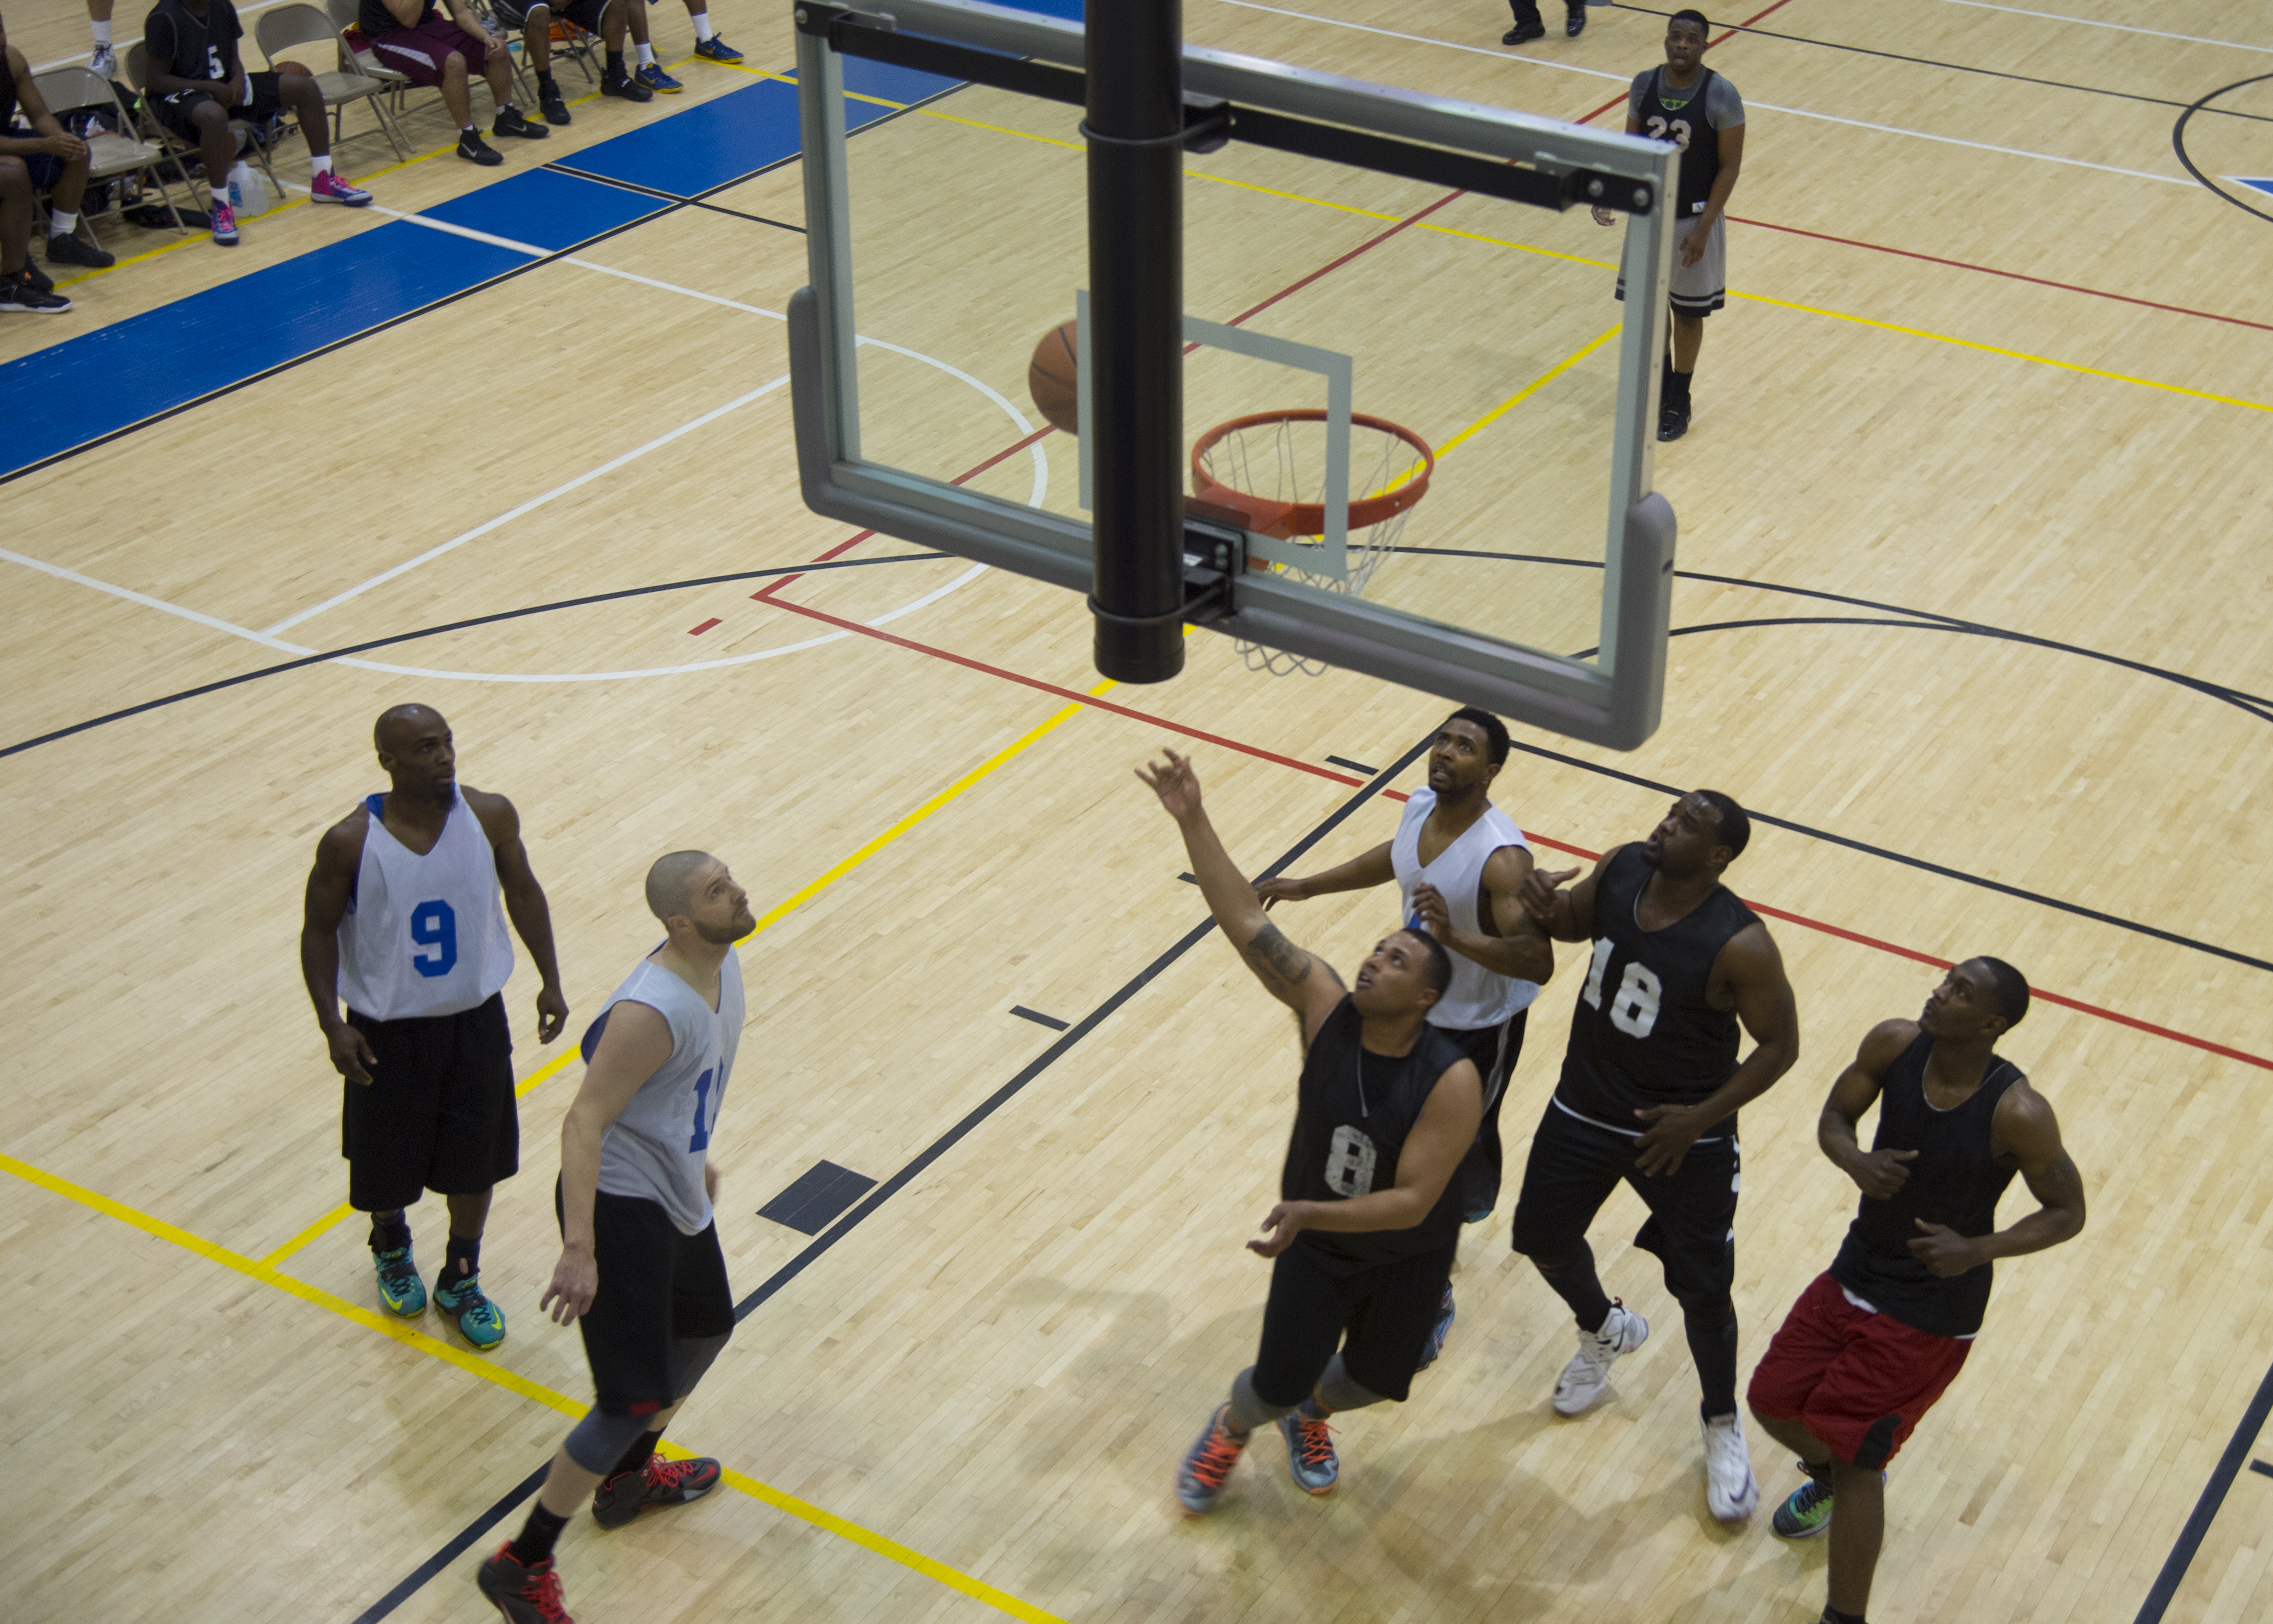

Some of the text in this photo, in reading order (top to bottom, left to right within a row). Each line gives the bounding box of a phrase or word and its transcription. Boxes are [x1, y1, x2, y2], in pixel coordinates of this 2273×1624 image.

[208, 45, 225, 79] 5
[411, 899, 457, 977] 9
[1583, 936, 1662, 1039] 18
[689, 1055, 724, 1153] 1
[1324, 1124, 1377, 1198] 8
